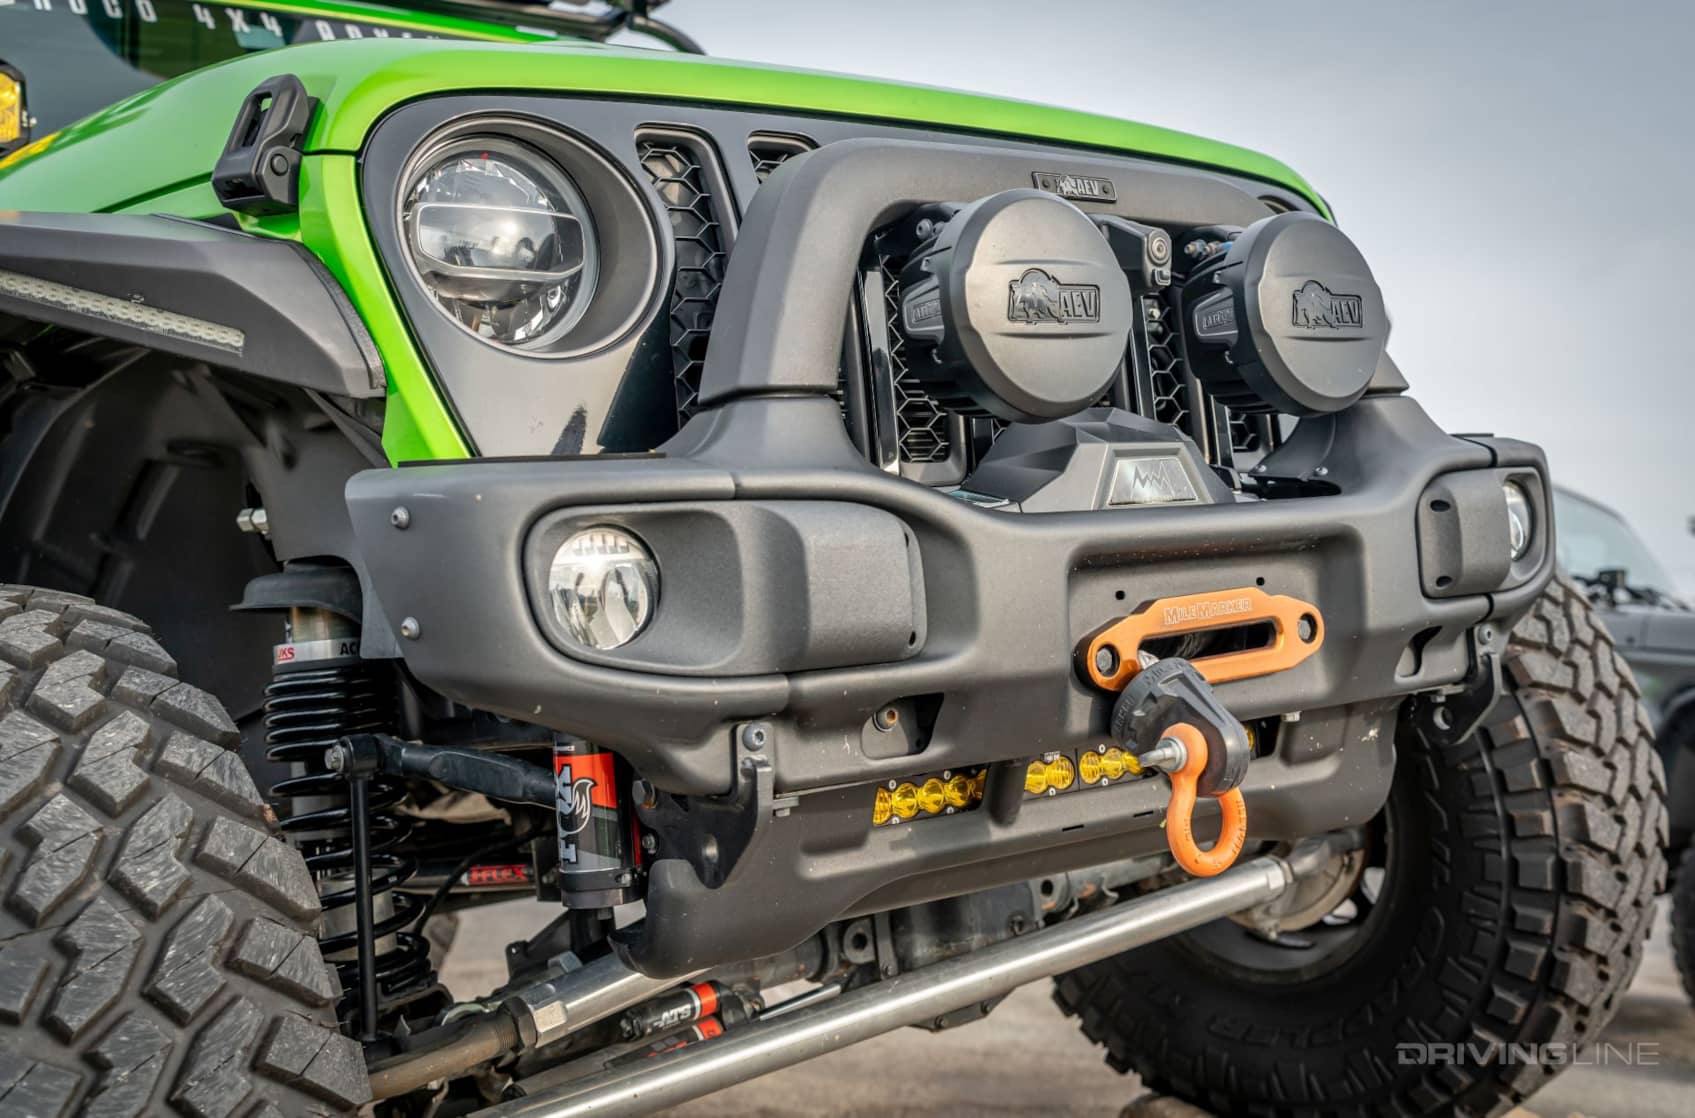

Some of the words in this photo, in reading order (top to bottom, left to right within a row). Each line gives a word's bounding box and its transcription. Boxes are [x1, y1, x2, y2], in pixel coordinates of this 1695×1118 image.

[192, 4, 283, 37] 4X4
[1076, 178, 1099, 196] AEV
[1059, 289, 1097, 318] AEV
[1331, 298, 1361, 325] AEV
